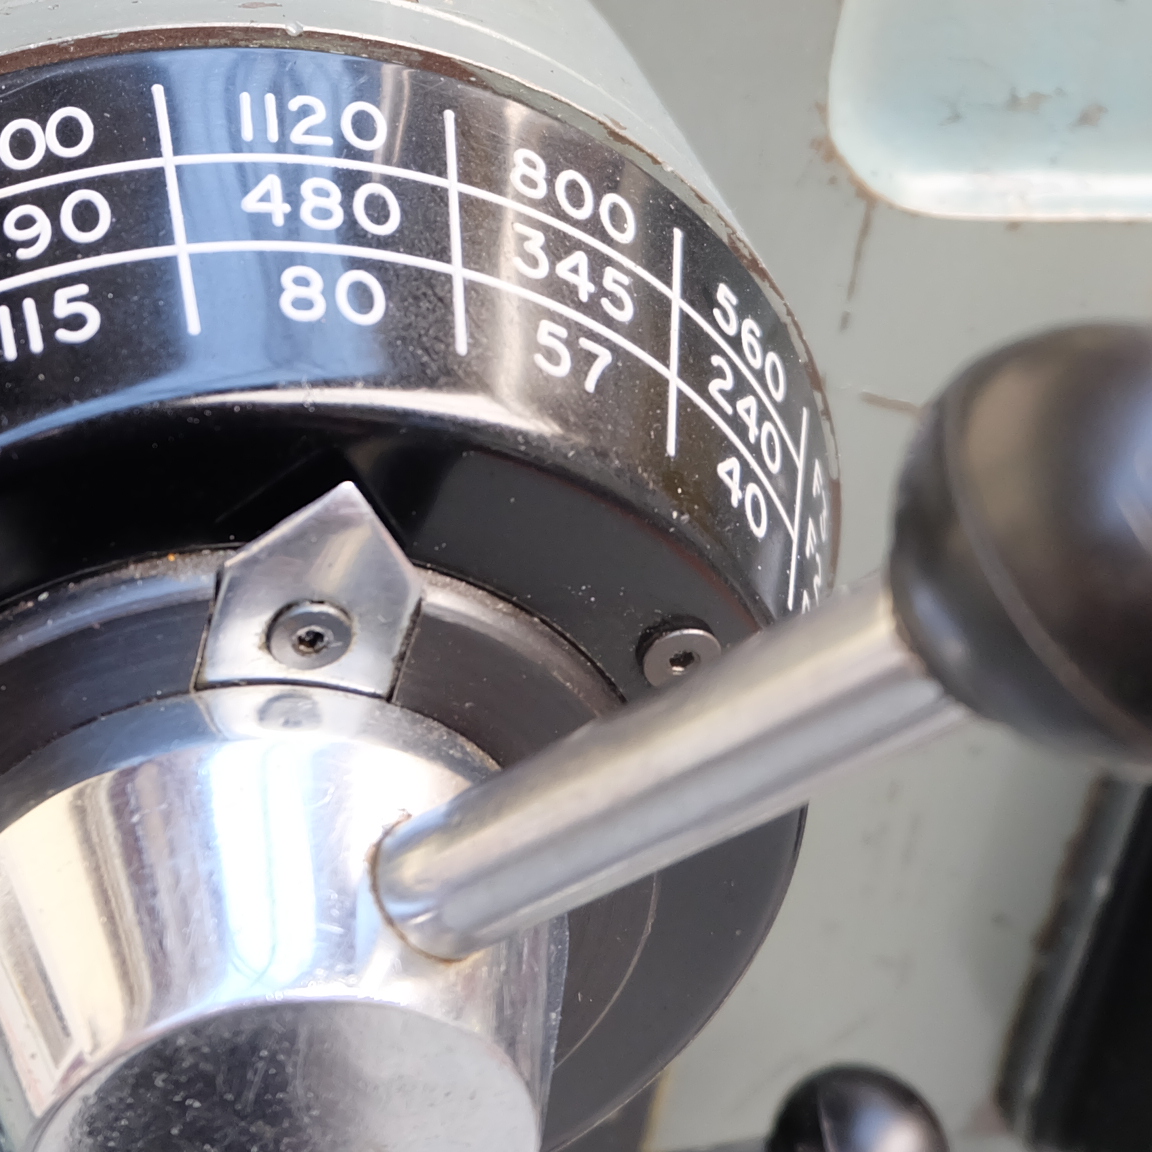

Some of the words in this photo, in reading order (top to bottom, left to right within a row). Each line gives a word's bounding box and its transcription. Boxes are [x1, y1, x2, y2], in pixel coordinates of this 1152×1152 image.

[239, 92, 388, 151] 1120
[240, 174, 402, 236] 480
[509, 148, 637, 245] 800
[279, 266, 386, 326] 80
[511, 222, 635, 323] 345
[534, 320, 613, 393] 57
[713, 283, 786, 403] 560
[708, 355, 782, 474] 240
[717, 456, 768, 539] 40
